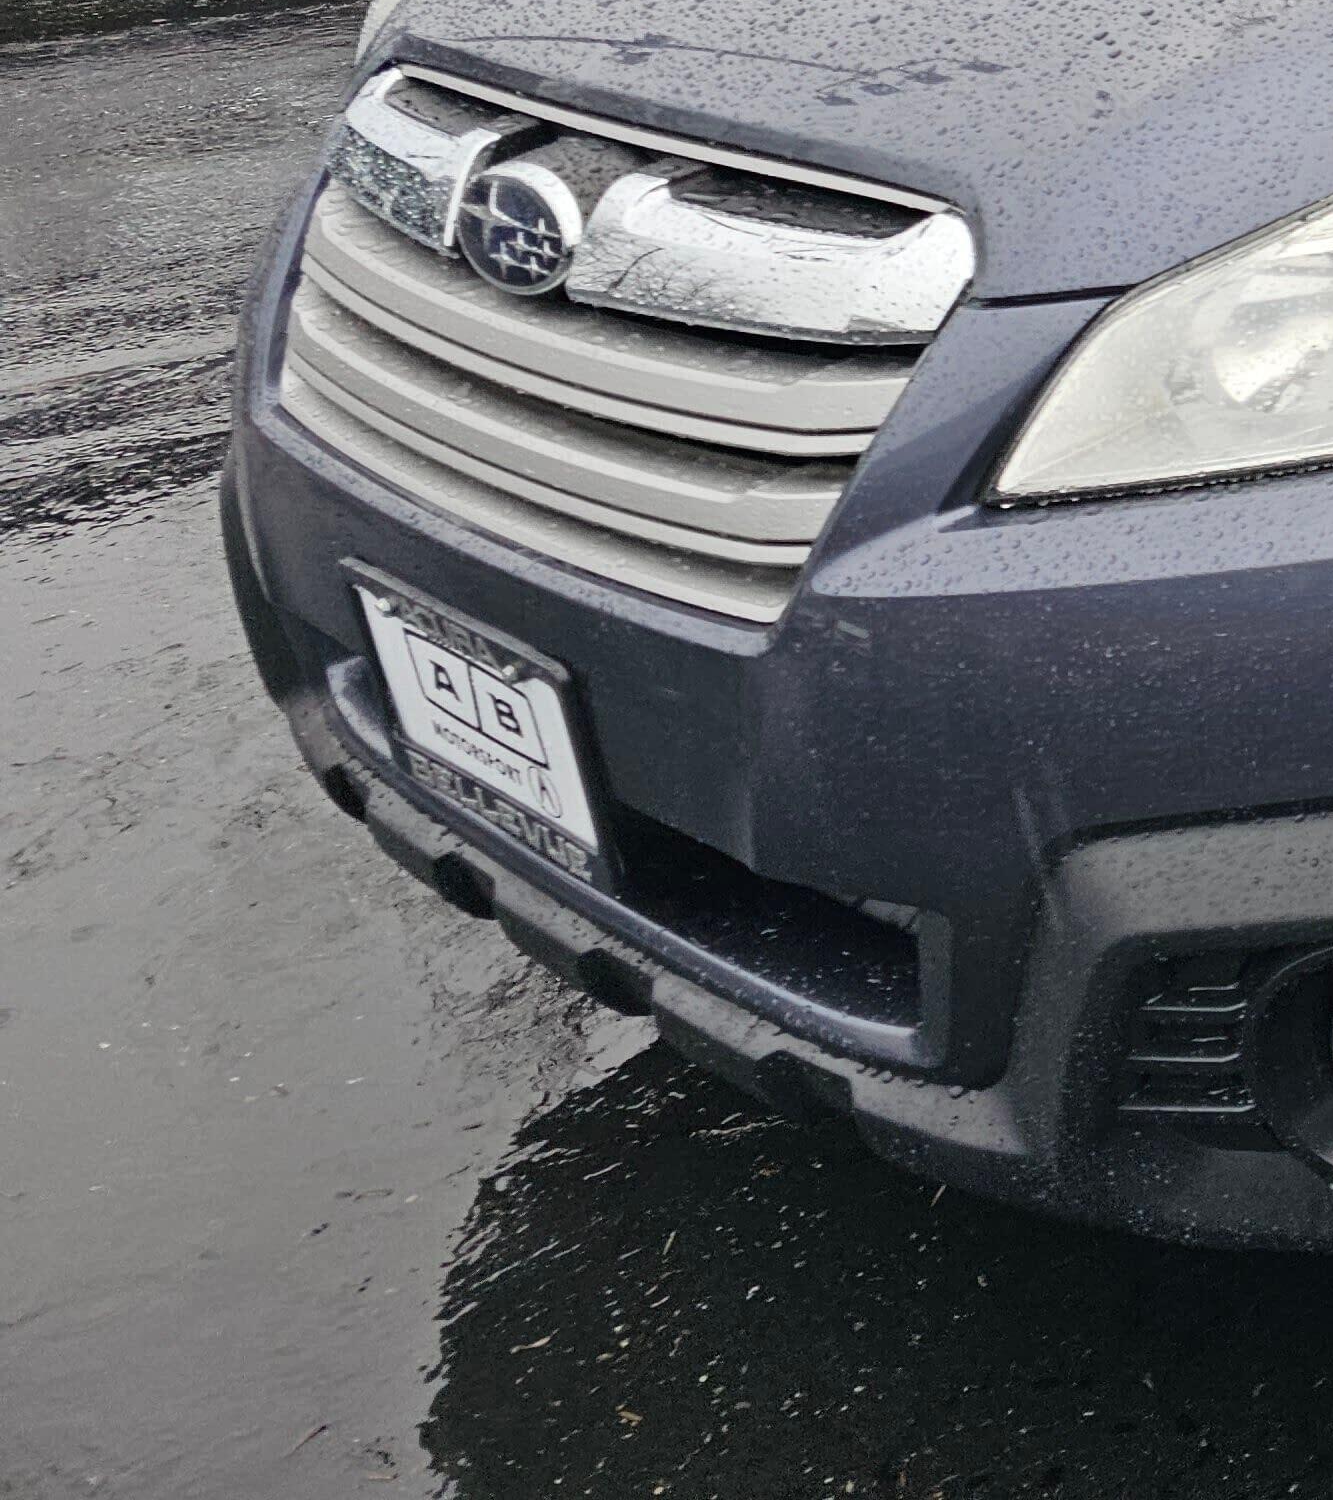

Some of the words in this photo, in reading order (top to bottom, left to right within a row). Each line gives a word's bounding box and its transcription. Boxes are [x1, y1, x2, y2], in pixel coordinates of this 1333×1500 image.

[429, 659, 461, 702] A
[486, 691, 524, 739] B
[408, 751, 593, 883] BELLEVUE
